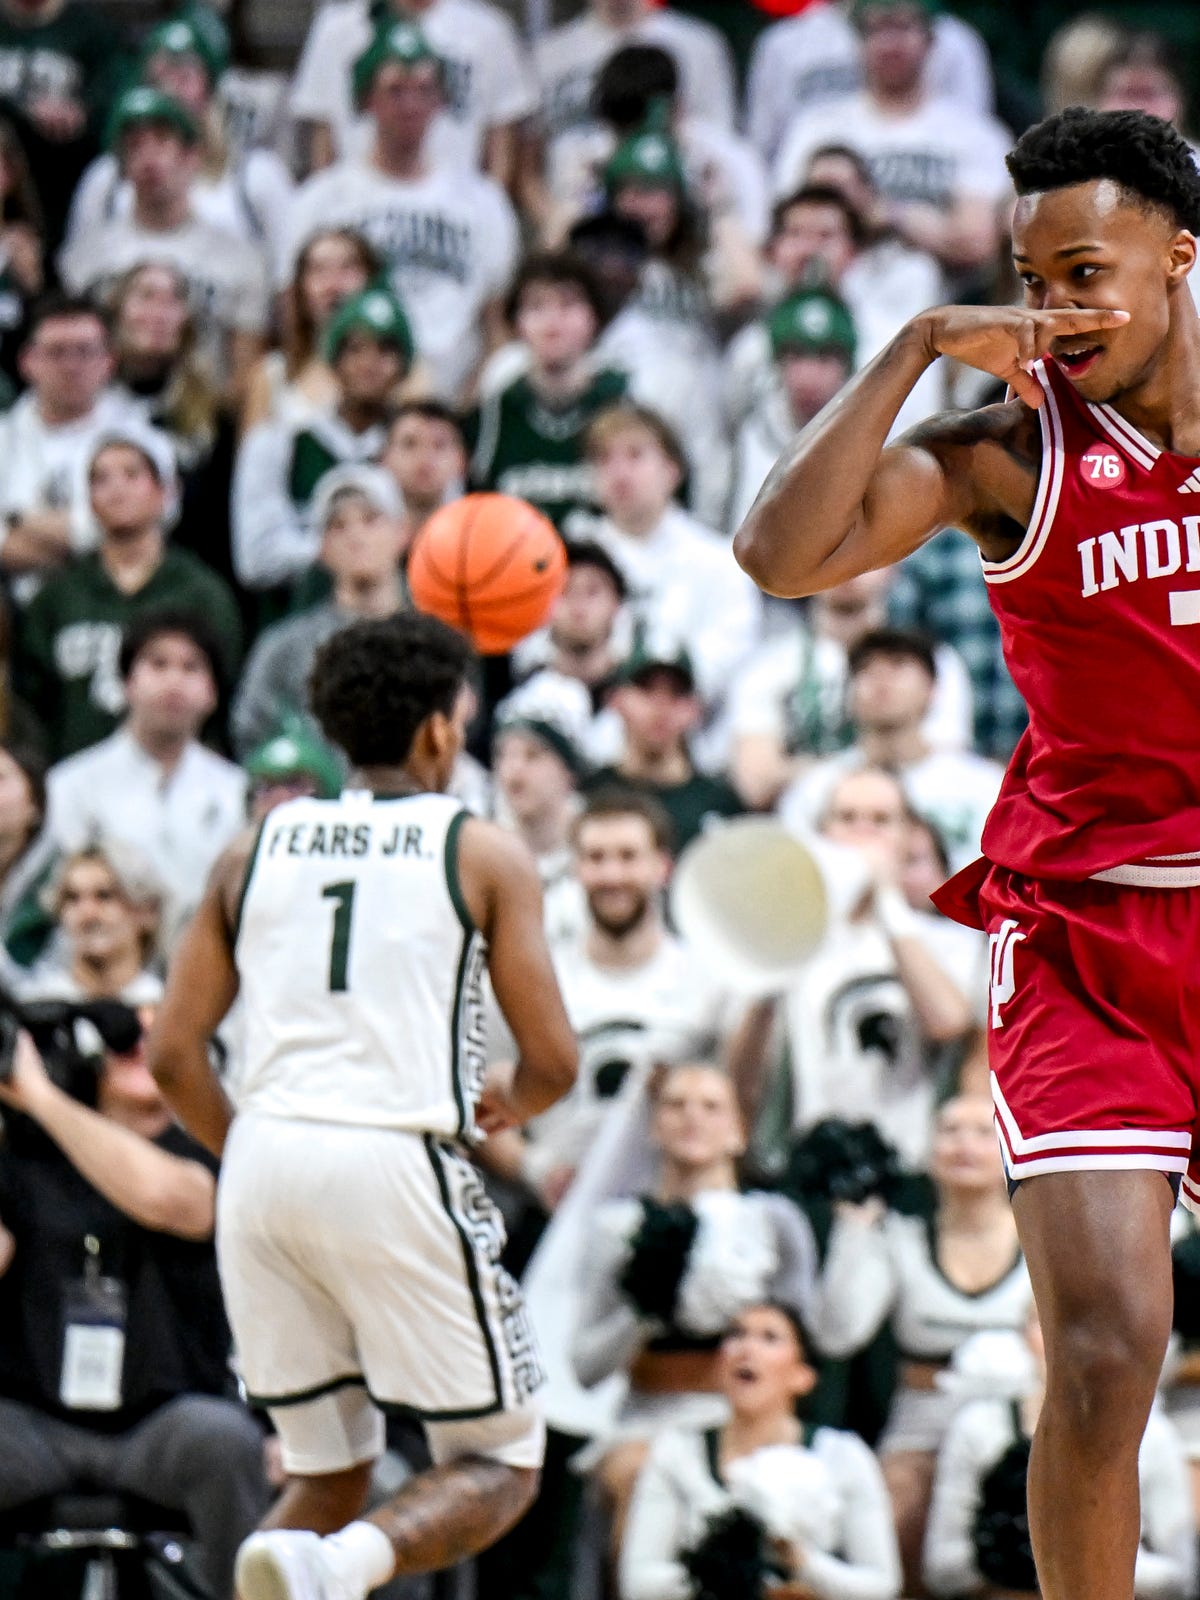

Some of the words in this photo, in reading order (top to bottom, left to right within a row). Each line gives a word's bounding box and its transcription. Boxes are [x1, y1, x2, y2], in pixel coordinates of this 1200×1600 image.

[1083, 454, 1120, 479] '76
[268, 822, 371, 857] FEARS
[382, 823, 434, 858] JR.
[321, 878, 358, 992] 1
